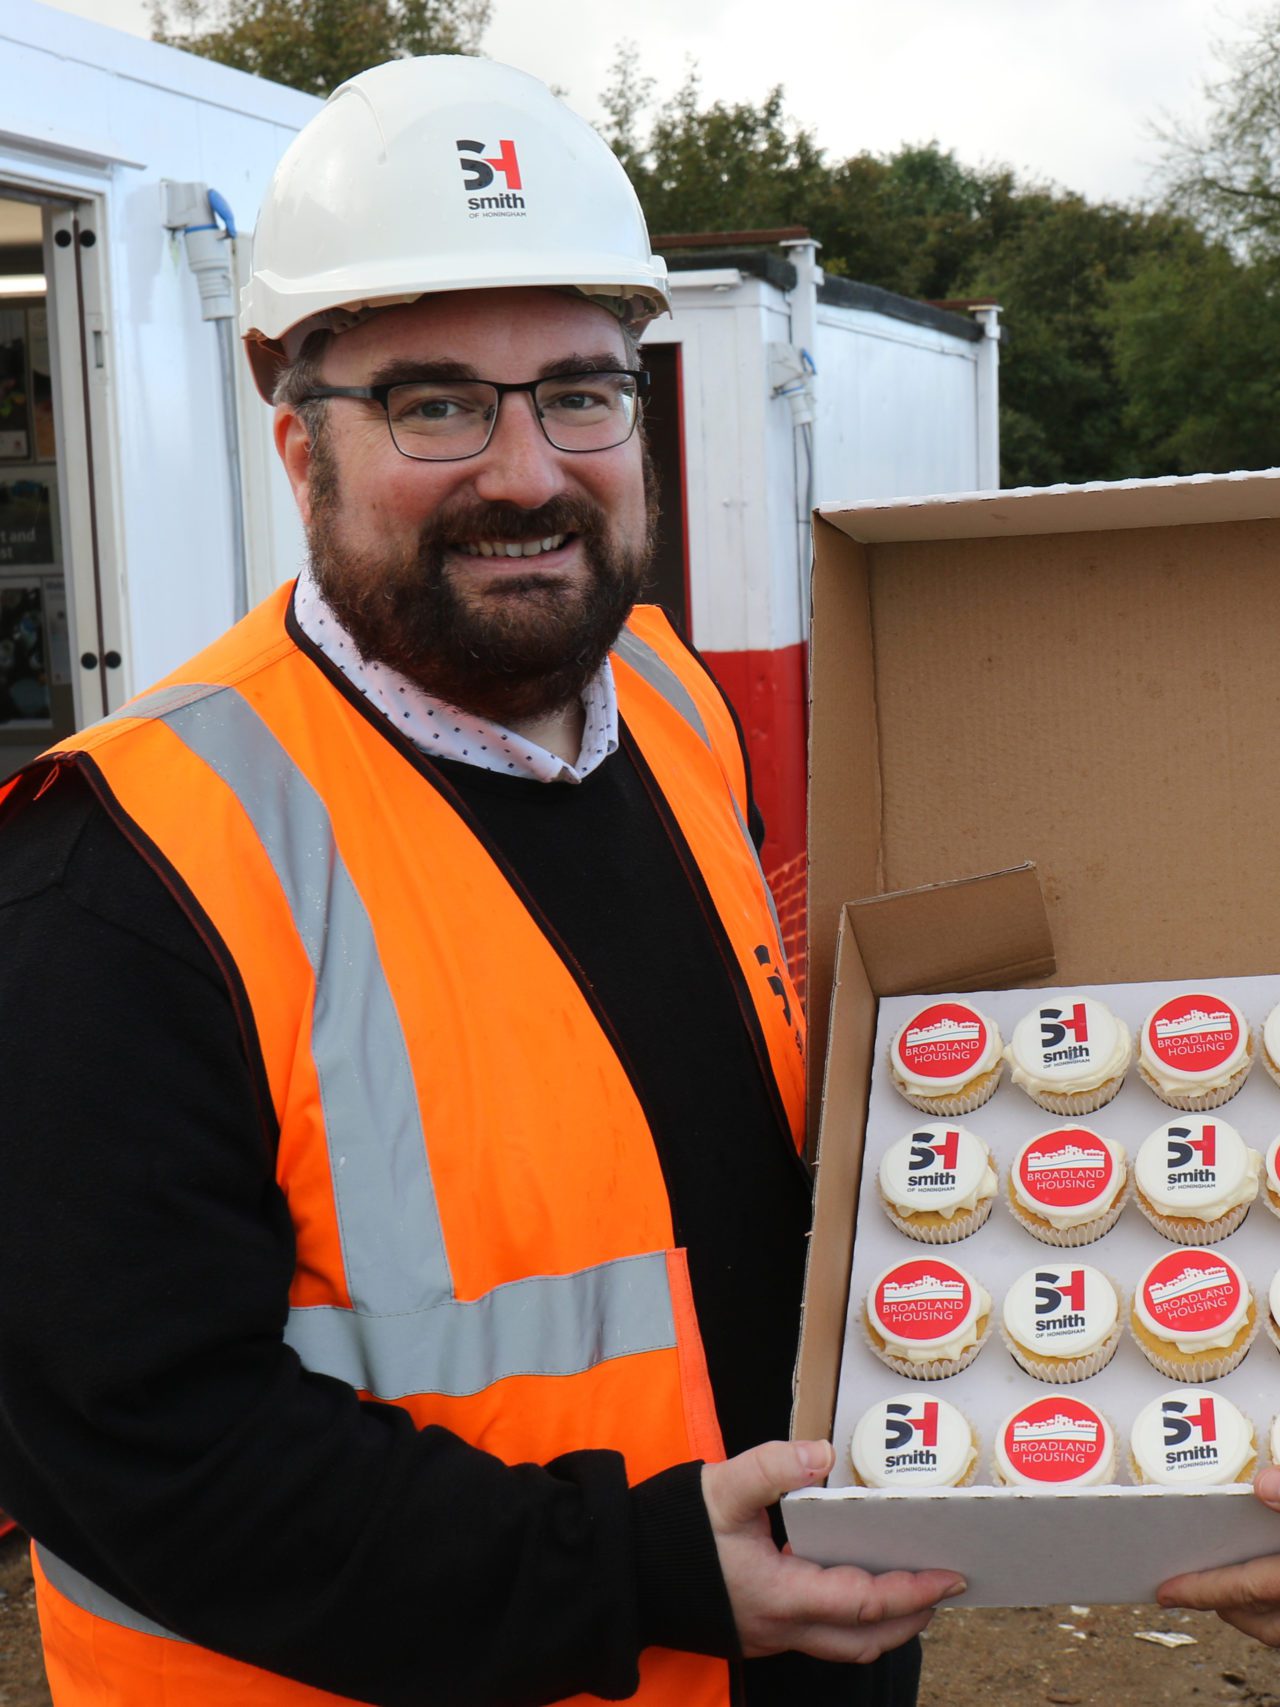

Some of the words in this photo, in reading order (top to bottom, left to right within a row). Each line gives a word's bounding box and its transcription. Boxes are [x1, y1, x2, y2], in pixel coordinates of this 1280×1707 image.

[467, 193, 525, 210] smith
[1157, 1032, 1233, 1048] BROADLAND
[905, 1040, 979, 1056] BROADLAND
[1043, 1046, 1089, 1063] smith
[1168, 1043, 1225, 1056] HOUSING
[914, 1051, 970, 1064] HOUSING
[1054, 1059, 1090, 1068] HONINGHAM
[908, 1173, 956, 1186] smith
[1027, 1169, 1105, 1182] BROADLAND
[1168, 1169, 1215, 1183] smith
[1037, 1180, 1095, 1190] HOUSING
[1154, 1285, 1234, 1314] BROADLAND
[883, 1301, 964, 1314] BROADLAND
[1167, 1298, 1228, 1320] HOUSING
[892, 1311, 953, 1322] HOUSING
[1035, 1314, 1085, 1331] smith
[1047, 1329, 1085, 1337] HONINGHAM
[1012, 1442, 1096, 1453] BROADLAND
[885, 1450, 936, 1467] smith
[1022, 1453, 1085, 1463] HOUSING
[1166, 1446, 1218, 1463] smith
[1177, 1460, 1218, 1469] HONINGHAM
